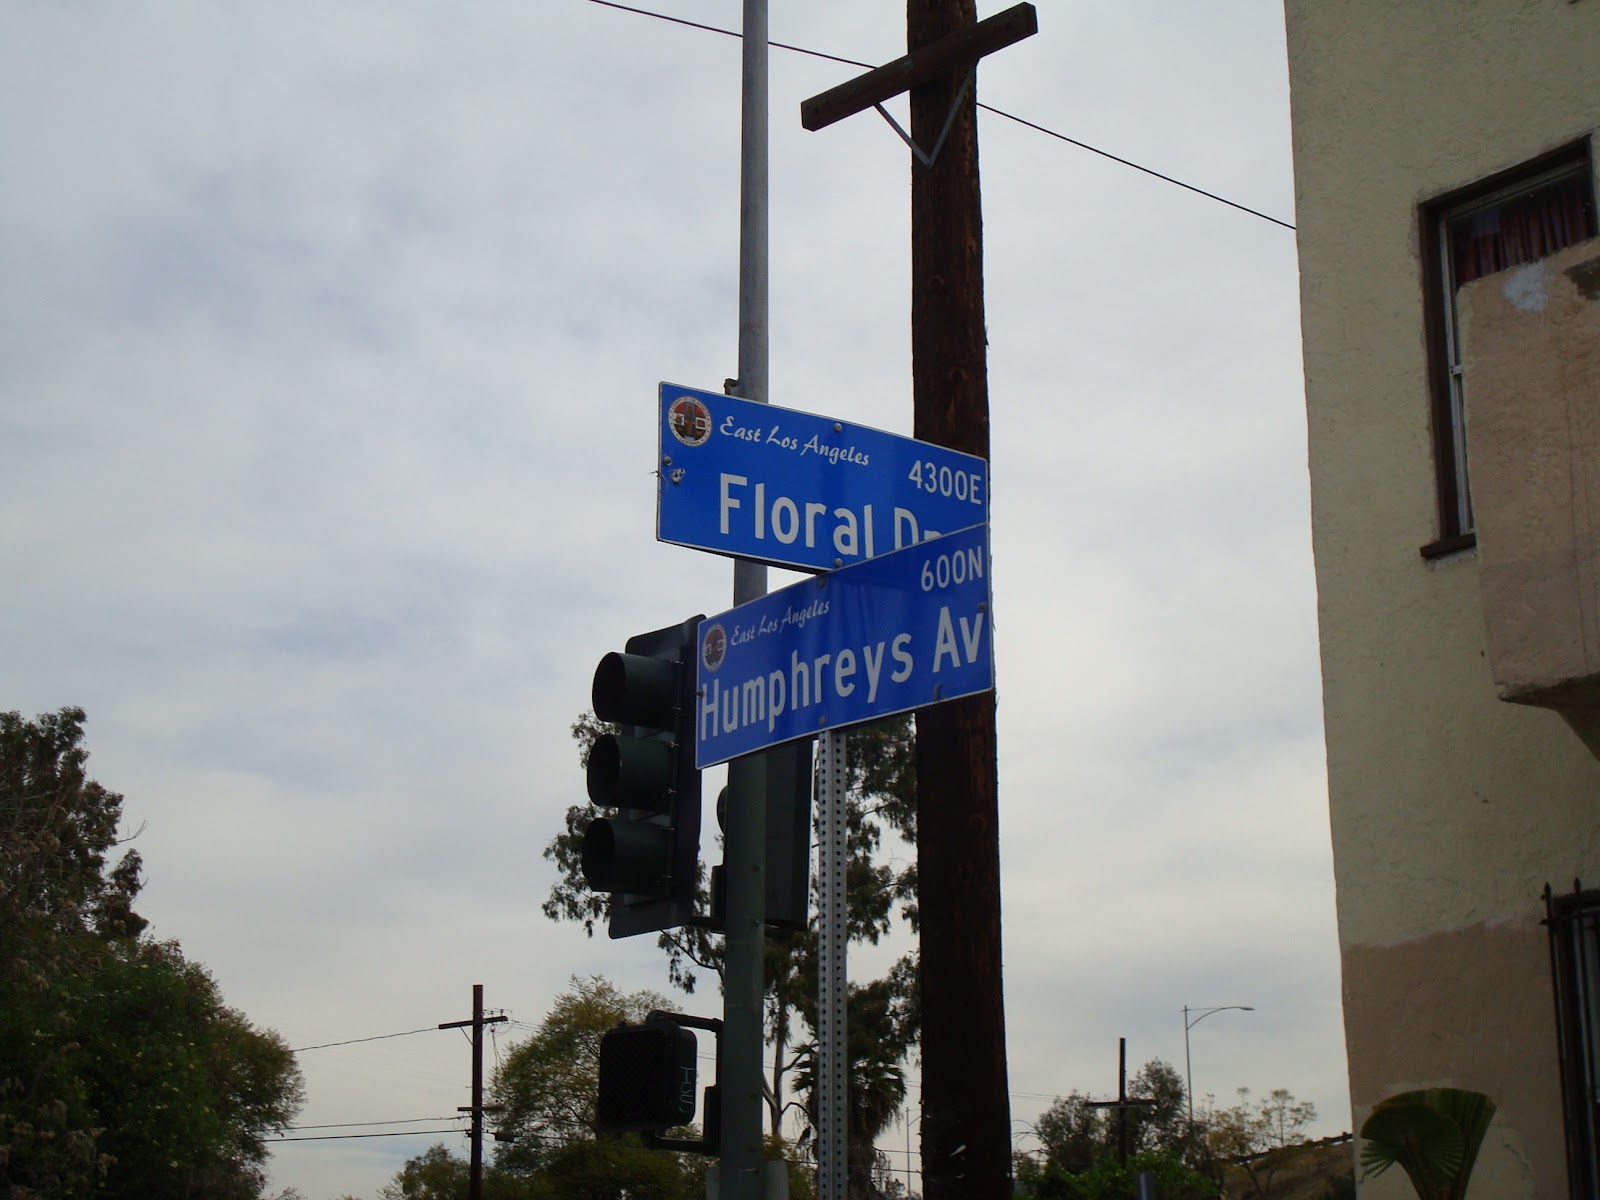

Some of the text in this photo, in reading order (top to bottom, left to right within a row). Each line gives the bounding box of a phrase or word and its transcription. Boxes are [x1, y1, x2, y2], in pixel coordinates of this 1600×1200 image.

[720, 416, 761, 442] East
[766, 425, 798, 450] Los
[800, 434, 870, 466] Angeles
[908, 460, 982, 505] 4300E
[720, 473, 942, 559] Floral D
[921, 545, 983, 591] 600N
[731, 599, 830, 646] East Los Angeles
[701, 633, 914, 741] Humphreys
[932, 606, 984, 674] Av
